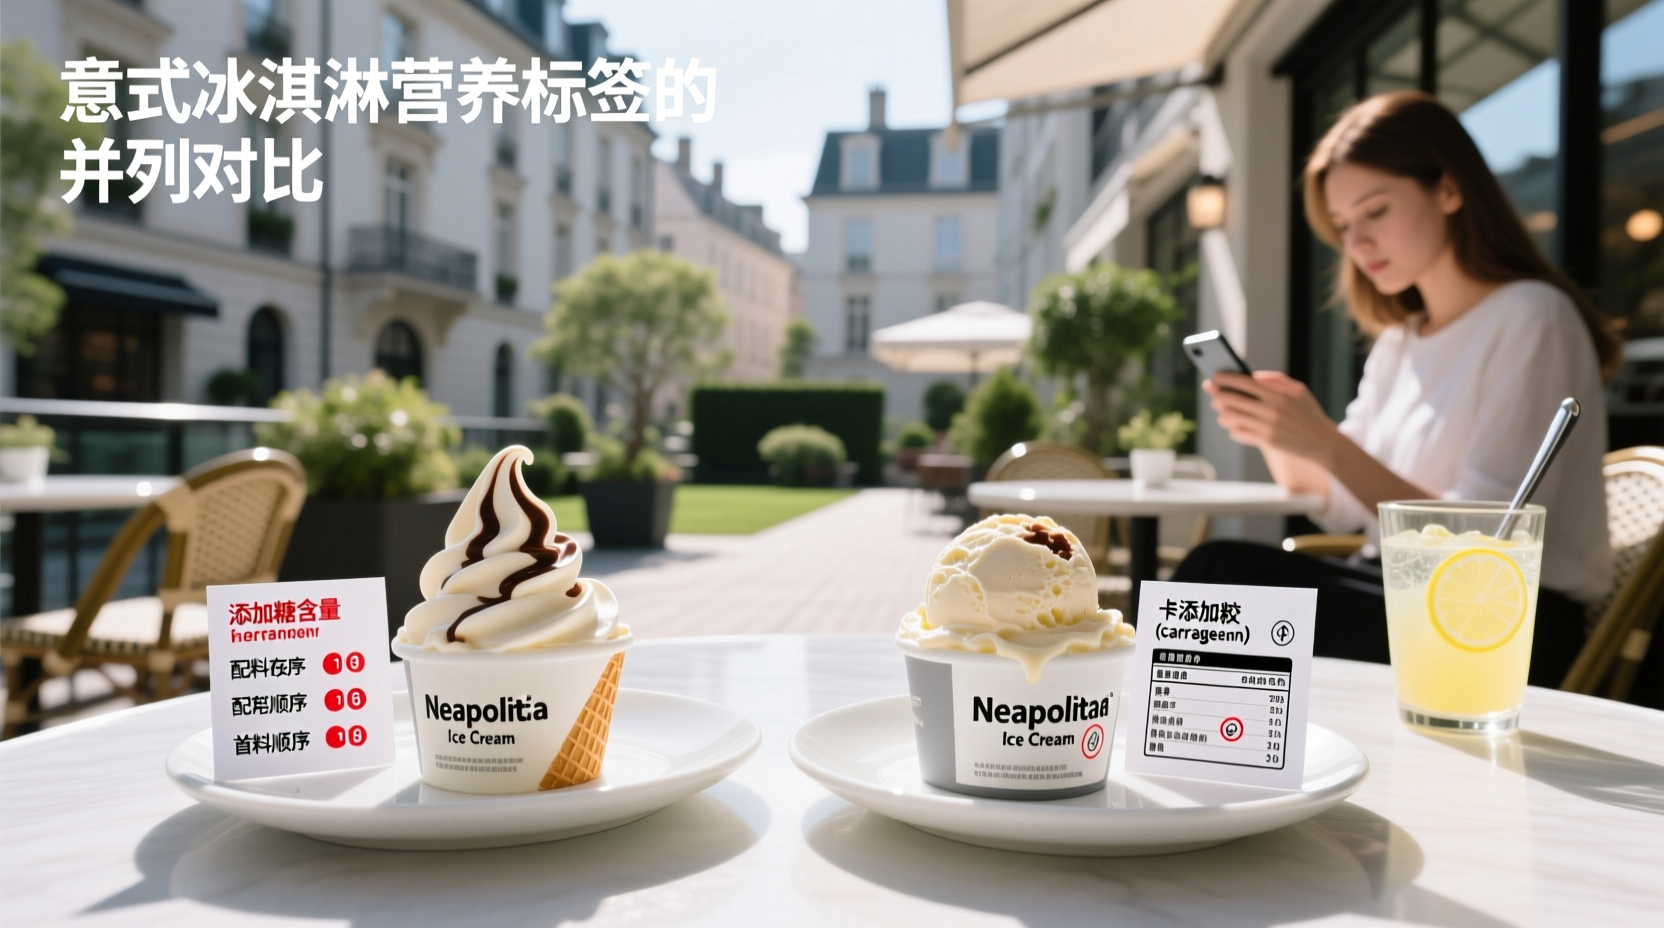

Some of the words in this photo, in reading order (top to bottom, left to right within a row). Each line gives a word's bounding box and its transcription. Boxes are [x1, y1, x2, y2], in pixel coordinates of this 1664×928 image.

[229, 598, 341, 626] 添加糖含量
[447, 728, 466, 744] Ice
[469, 729, 516, 746] Cream
[1002, 731, 1025, 747] Ice
[1028, 732, 1075, 747] Cream
